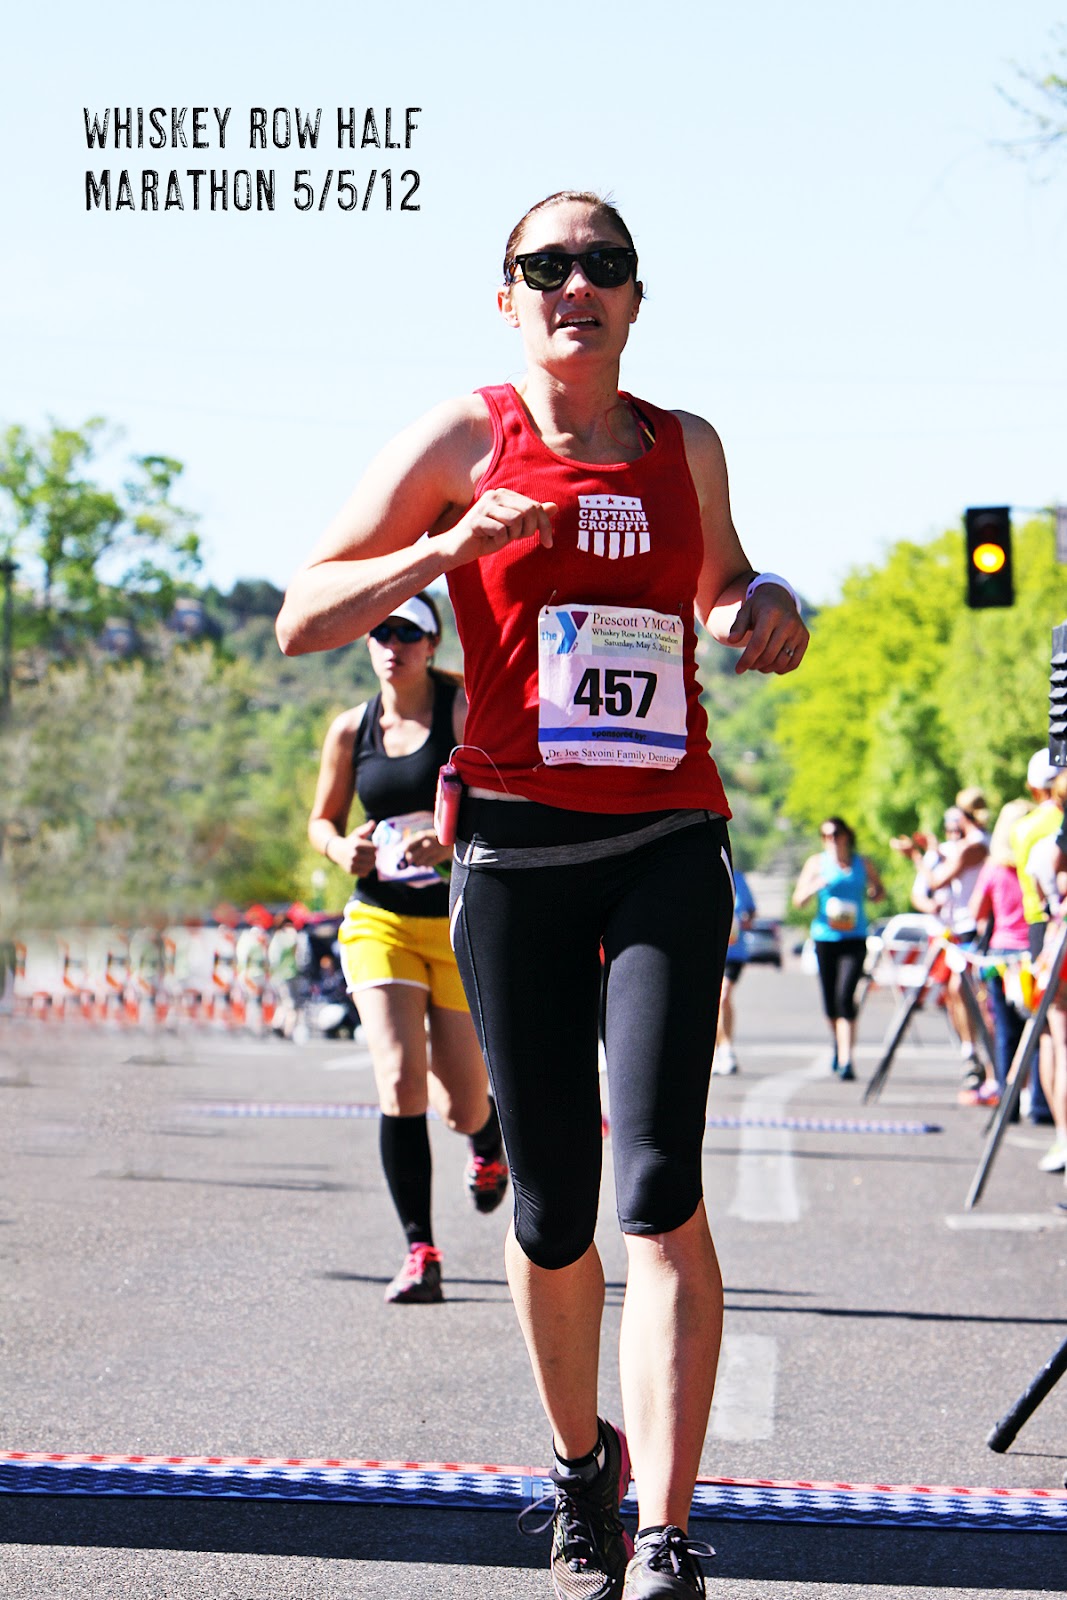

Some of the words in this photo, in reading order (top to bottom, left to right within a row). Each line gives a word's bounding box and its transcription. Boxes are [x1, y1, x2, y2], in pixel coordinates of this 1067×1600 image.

[579, 509, 647, 521] CAPTAIN
[578, 520, 649, 531] CROSSFIT
[593, 613, 638, 628] Prescott
[641, 616, 676, 633] YMCA
[541, 631, 557, 640] the
[592, 628, 620, 638] Whiskey
[621, 630, 636, 638] Row
[637, 631, 653, 639] Half
[604, 639, 635, 649] Saturday,
[636, 641, 650, 652] May
[573, 668, 658, 719] 457
[591, 730, 633, 739] sponsored
[548, 749, 562, 758] Dr.
[565, 749, 579, 757] Joe
[581, 748, 614, 758] Savoini
[617, 750, 647, 762] Family
